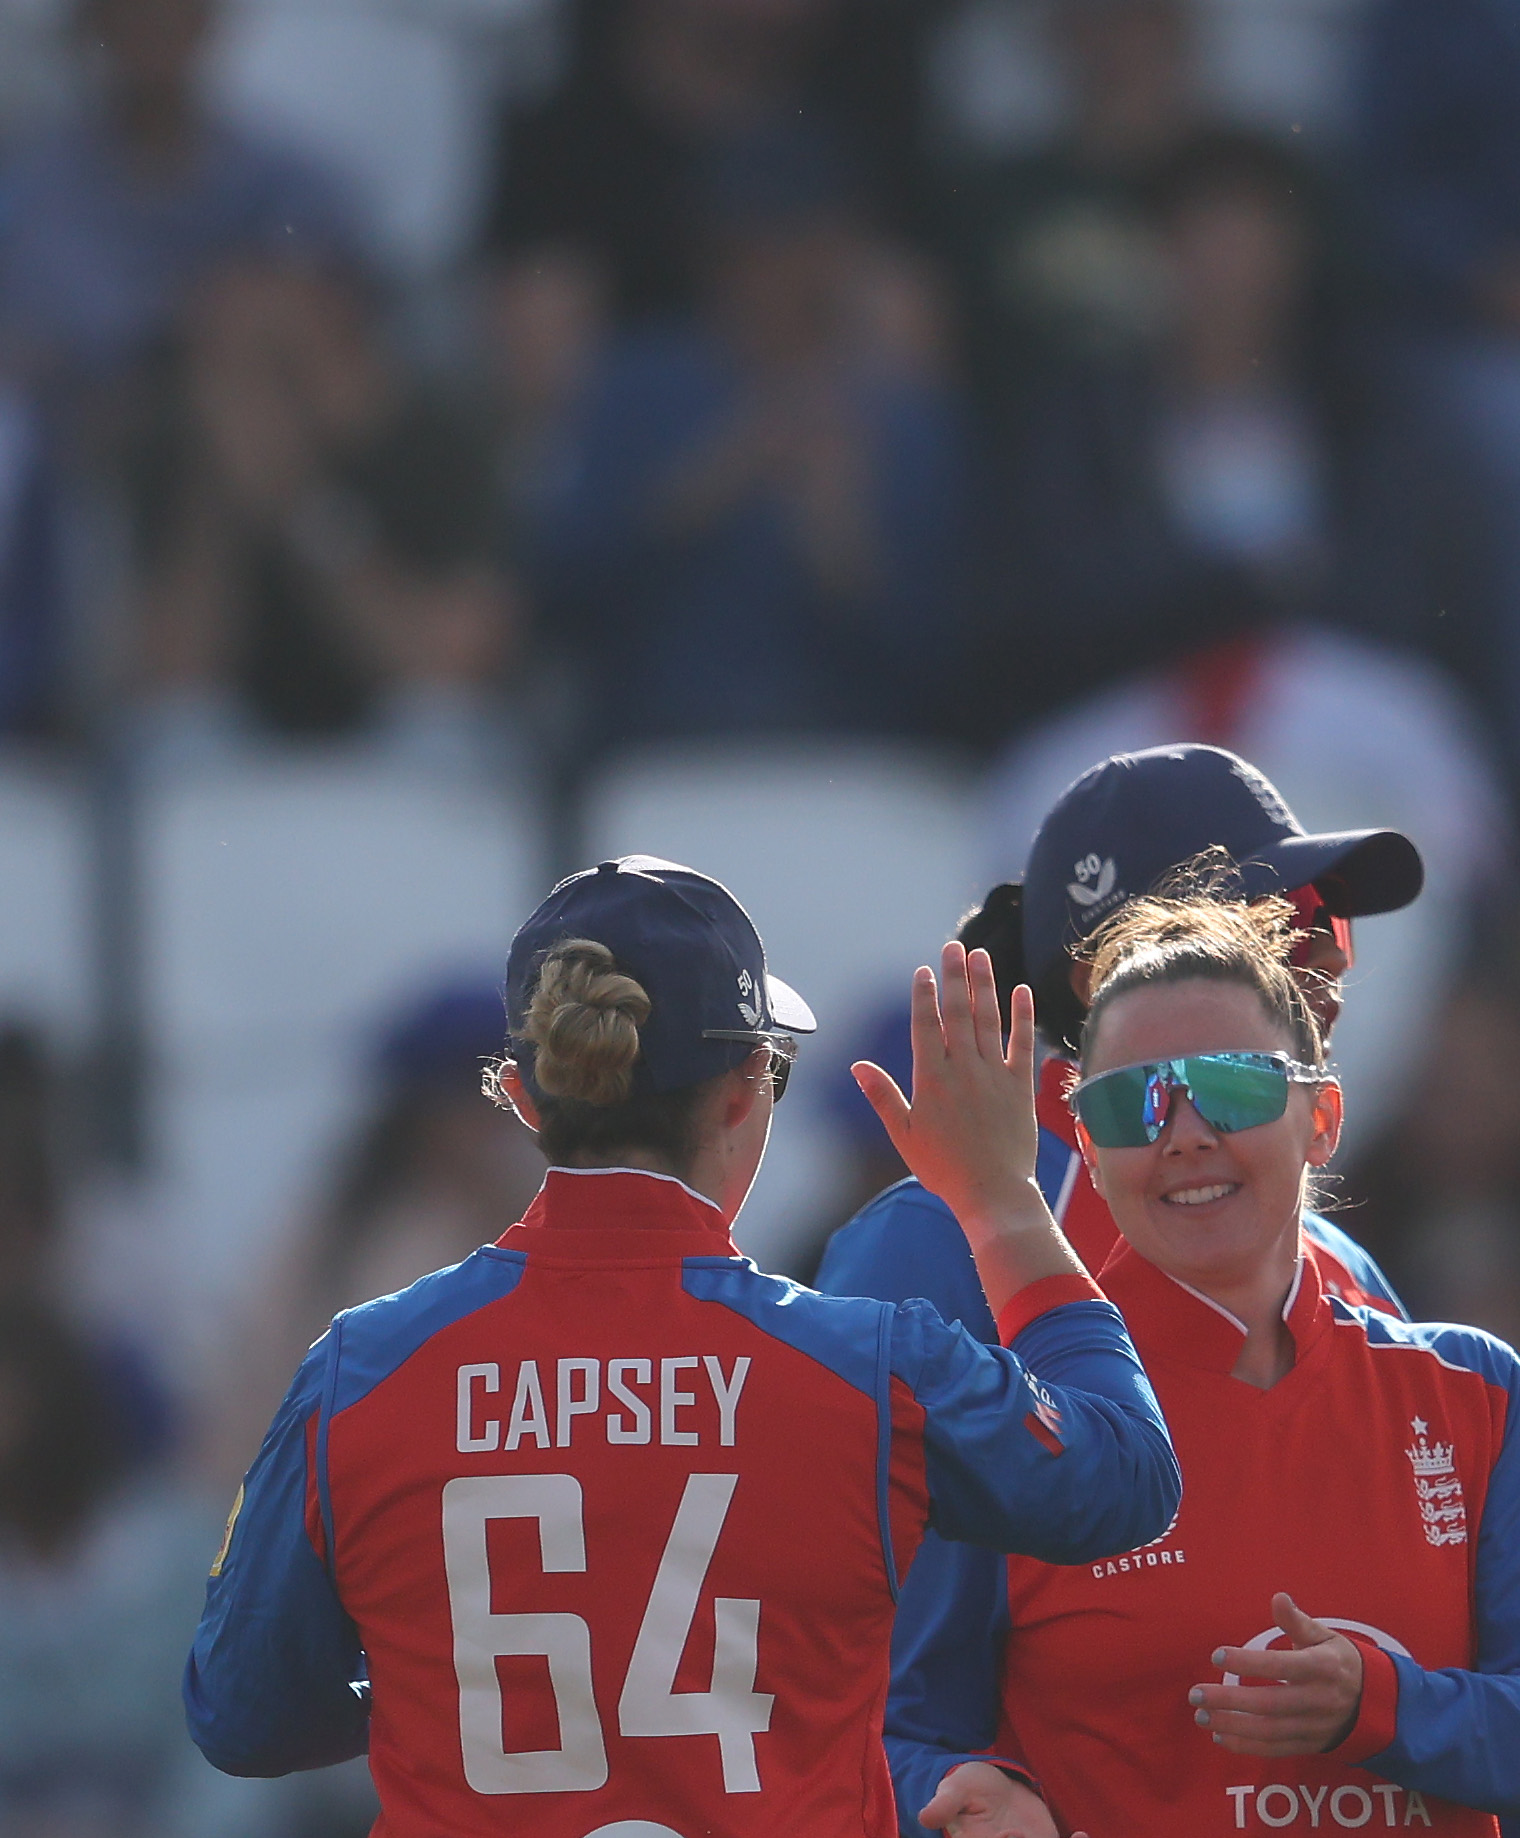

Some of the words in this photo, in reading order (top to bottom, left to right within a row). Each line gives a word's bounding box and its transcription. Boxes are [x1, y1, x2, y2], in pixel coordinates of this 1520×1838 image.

[1074, 853, 1101, 883] 50
[737, 969, 753, 997] 50
[456, 1355, 752, 1453] CAPSEY
[1092, 1550, 1186, 1579] CASTORE
[441, 1473, 776, 1795] 64
[1225, 1783, 1433, 1829] TOYOTA
